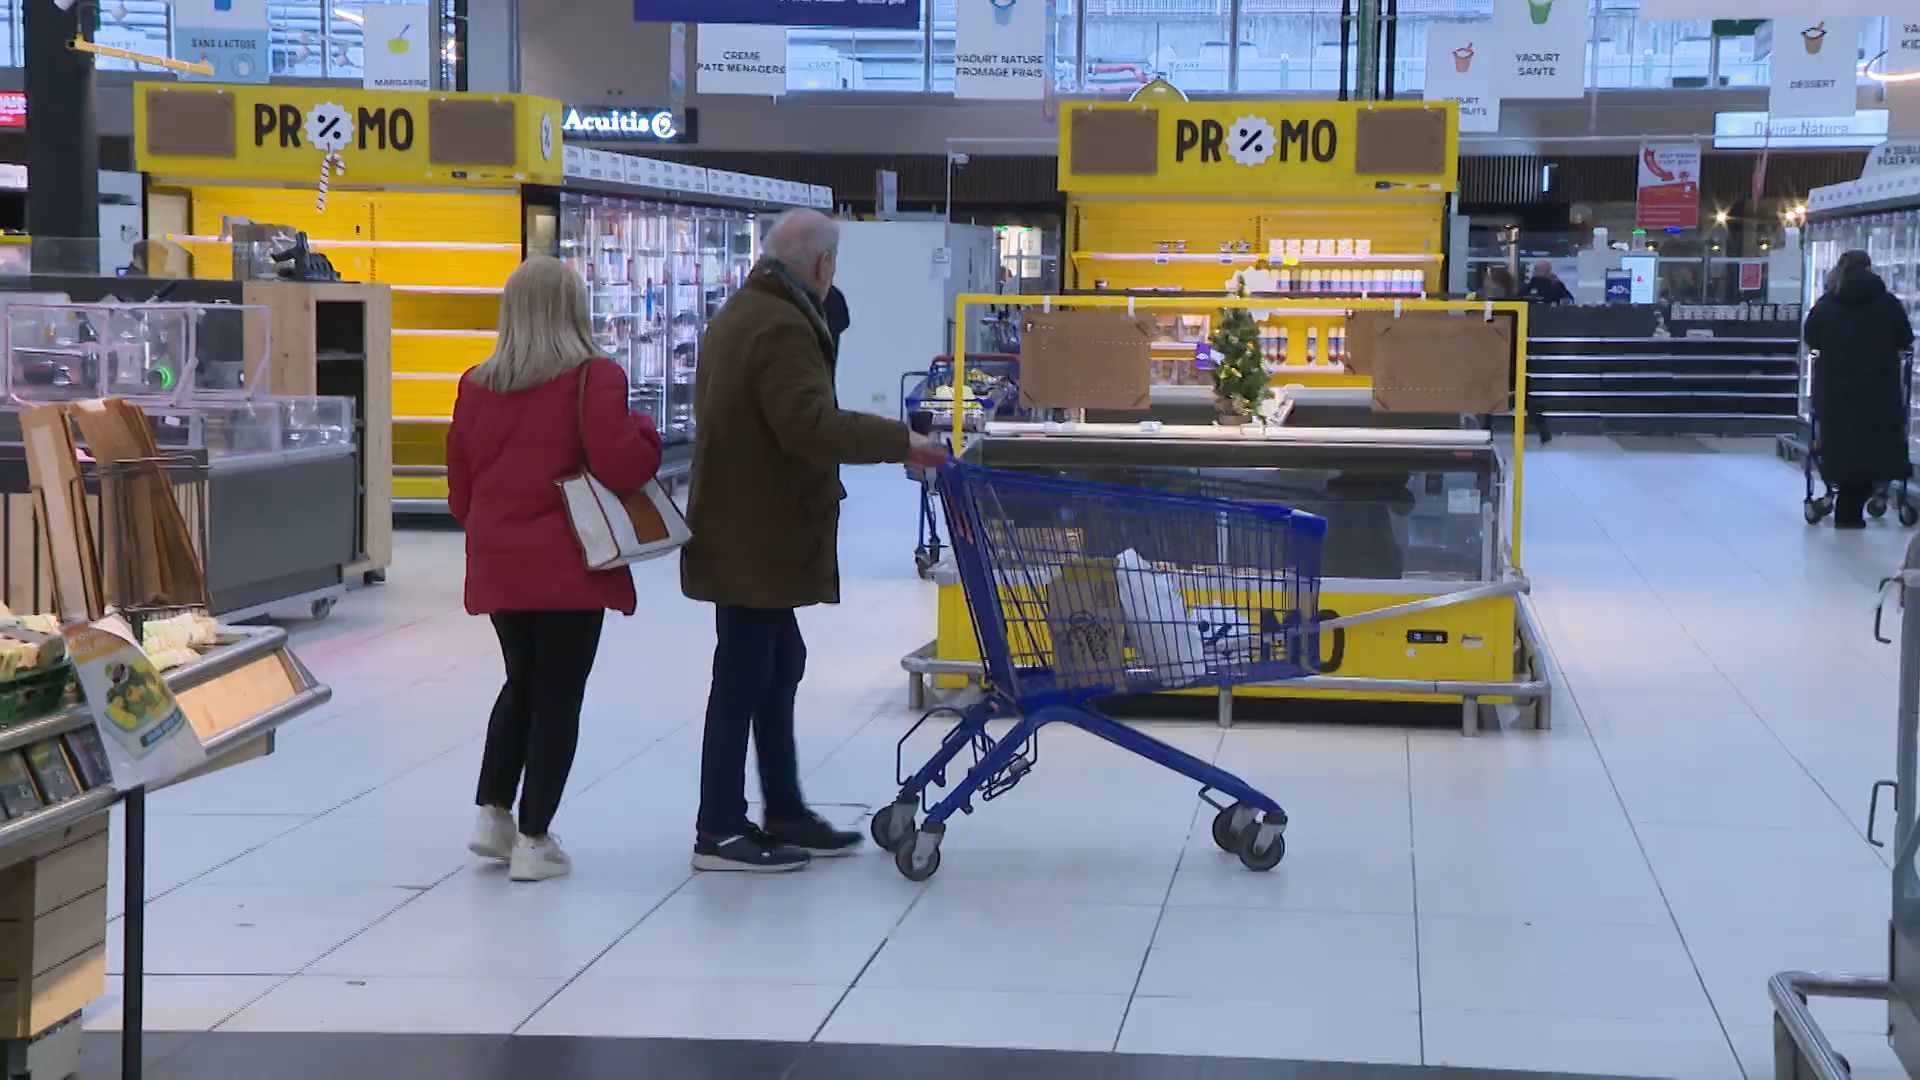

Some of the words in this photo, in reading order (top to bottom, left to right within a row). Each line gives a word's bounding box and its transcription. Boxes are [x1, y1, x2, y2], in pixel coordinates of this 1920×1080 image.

[1001, 55, 1044, 64] NATURE
[1516, 53, 1560, 62] YAOURT
[956, 67, 1009, 77] FROMAGE
[562, 108, 650, 132] Acuitis
[1801, 121, 1849, 137] Nature
